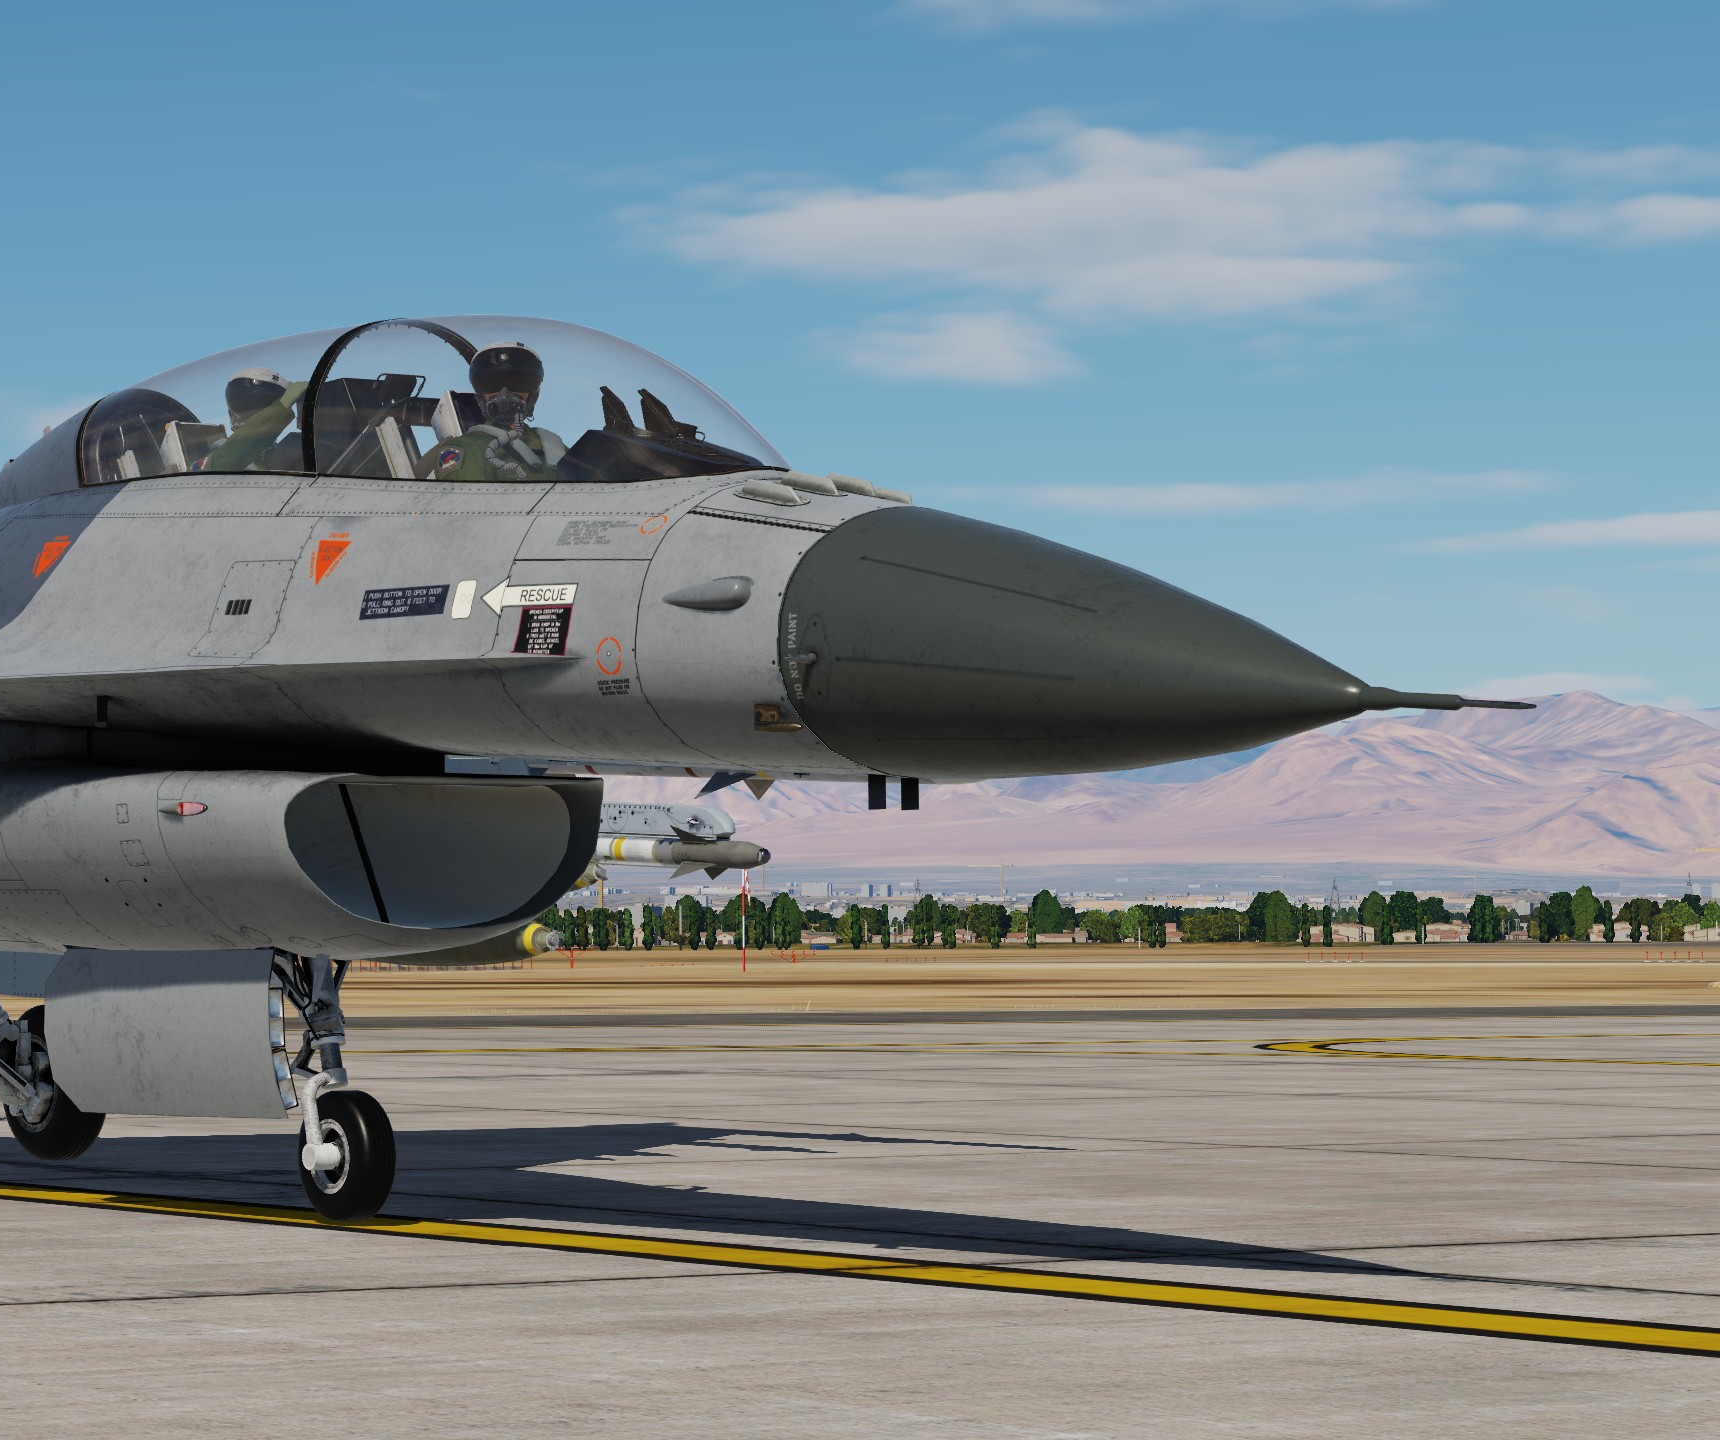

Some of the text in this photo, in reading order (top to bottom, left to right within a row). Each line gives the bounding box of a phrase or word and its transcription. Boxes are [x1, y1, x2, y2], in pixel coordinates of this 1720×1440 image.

[519, 588, 568, 602] RESCUE
[365, 606, 410, 615] JETTISON CANOPY
[787, 612, 797, 648] PAINT
[794, 684, 805, 699] DO
